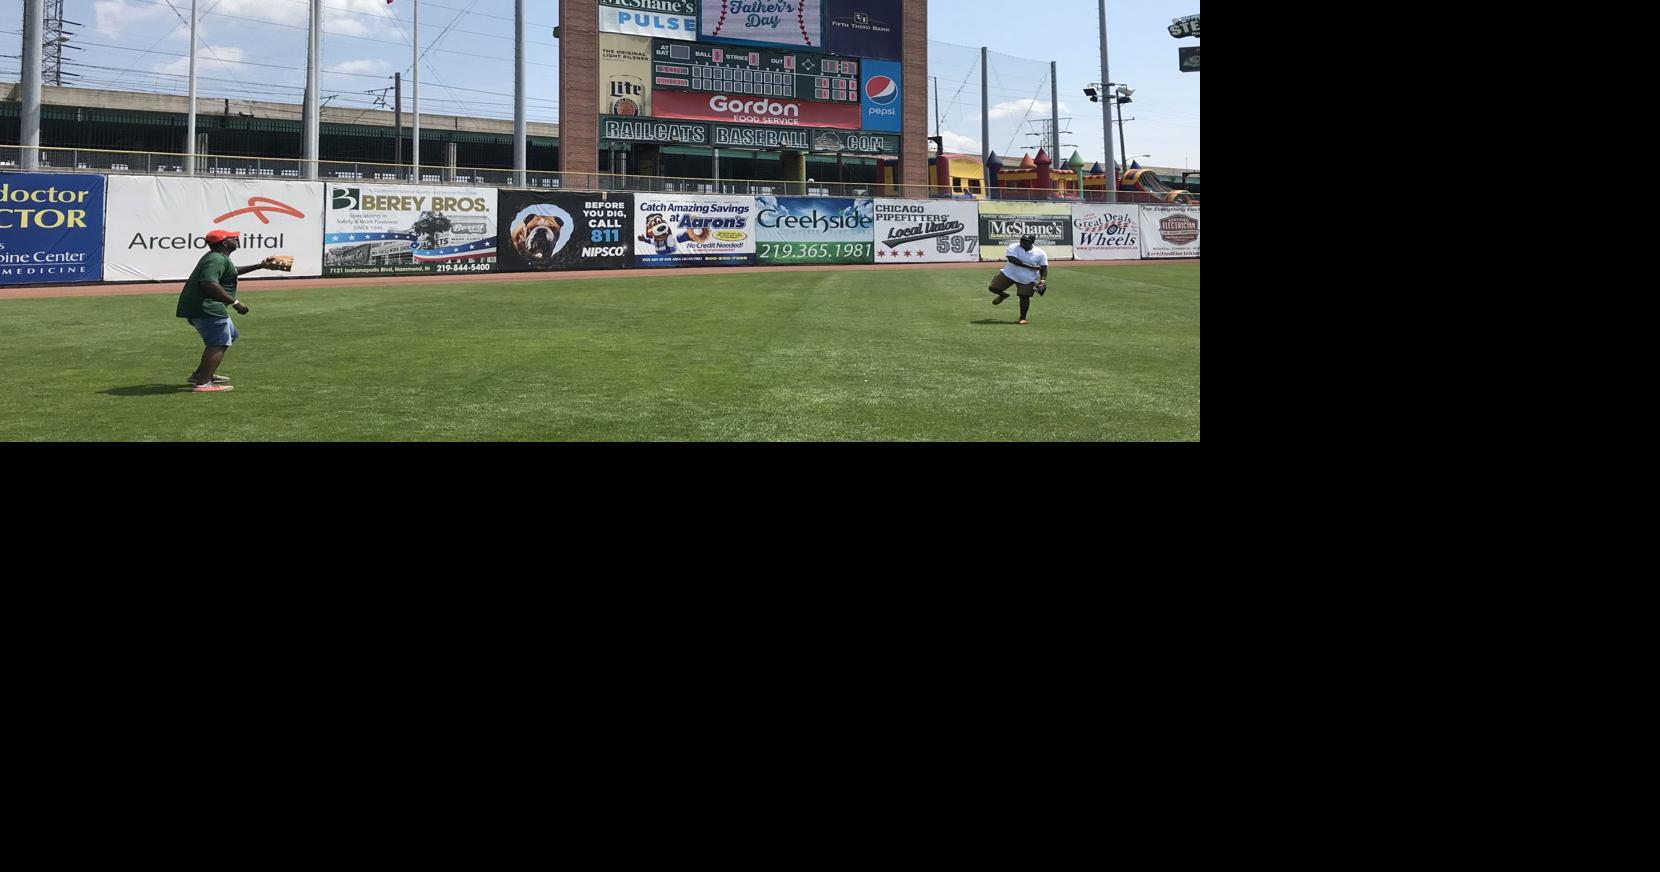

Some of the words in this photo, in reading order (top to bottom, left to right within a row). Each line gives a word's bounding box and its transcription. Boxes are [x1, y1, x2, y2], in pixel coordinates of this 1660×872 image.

[730, 1, 794, 14] Father's
[618, 12, 696, 31] PULSE
[745, 14, 780, 28] Day
[611, 81, 641, 97] Lite
[709, 95, 798, 116] Gordon
[868, 107, 896, 116] pepsi
[733, 115, 760, 123] FOOD
[762, 116, 799, 125] SERVICE
[605, 120, 705, 143] RAILCATS
[715, 127, 810, 149] BASEBALL
[362, 194, 425, 211] BEREY
[432, 196, 490, 212] BROS.
[640, 202, 666, 212] Catch
[667, 203, 709, 214] Amazing
[710, 203, 750, 214] Savings
[875, 204, 925, 213] CHICAGO
[606, 210, 627, 218] DIG,
[669, 213, 679, 222] at
[678, 214, 747, 229] Aaron's
[757, 208, 873, 232] Creekside
[1073, 218, 1103, 229] Great
[1103, 212, 1132, 224] Deals
[588, 219, 622, 228] CALL
[888, 222, 923, 239] Local
[925, 220, 961, 233] Union
[990, 220, 1062, 235] McShane's
[1106, 224, 1126, 236] On
[591, 229, 620, 242] 811
[1080, 232, 1137, 246] Wheels
[760, 243, 872, 258] 219.365.1981
[936, 235, 978, 254] 597
[33, 251, 86, 262] Center
[2, 266, 87, 275] MEDICINE
[436, 263, 490, 272] 219-844-5400
